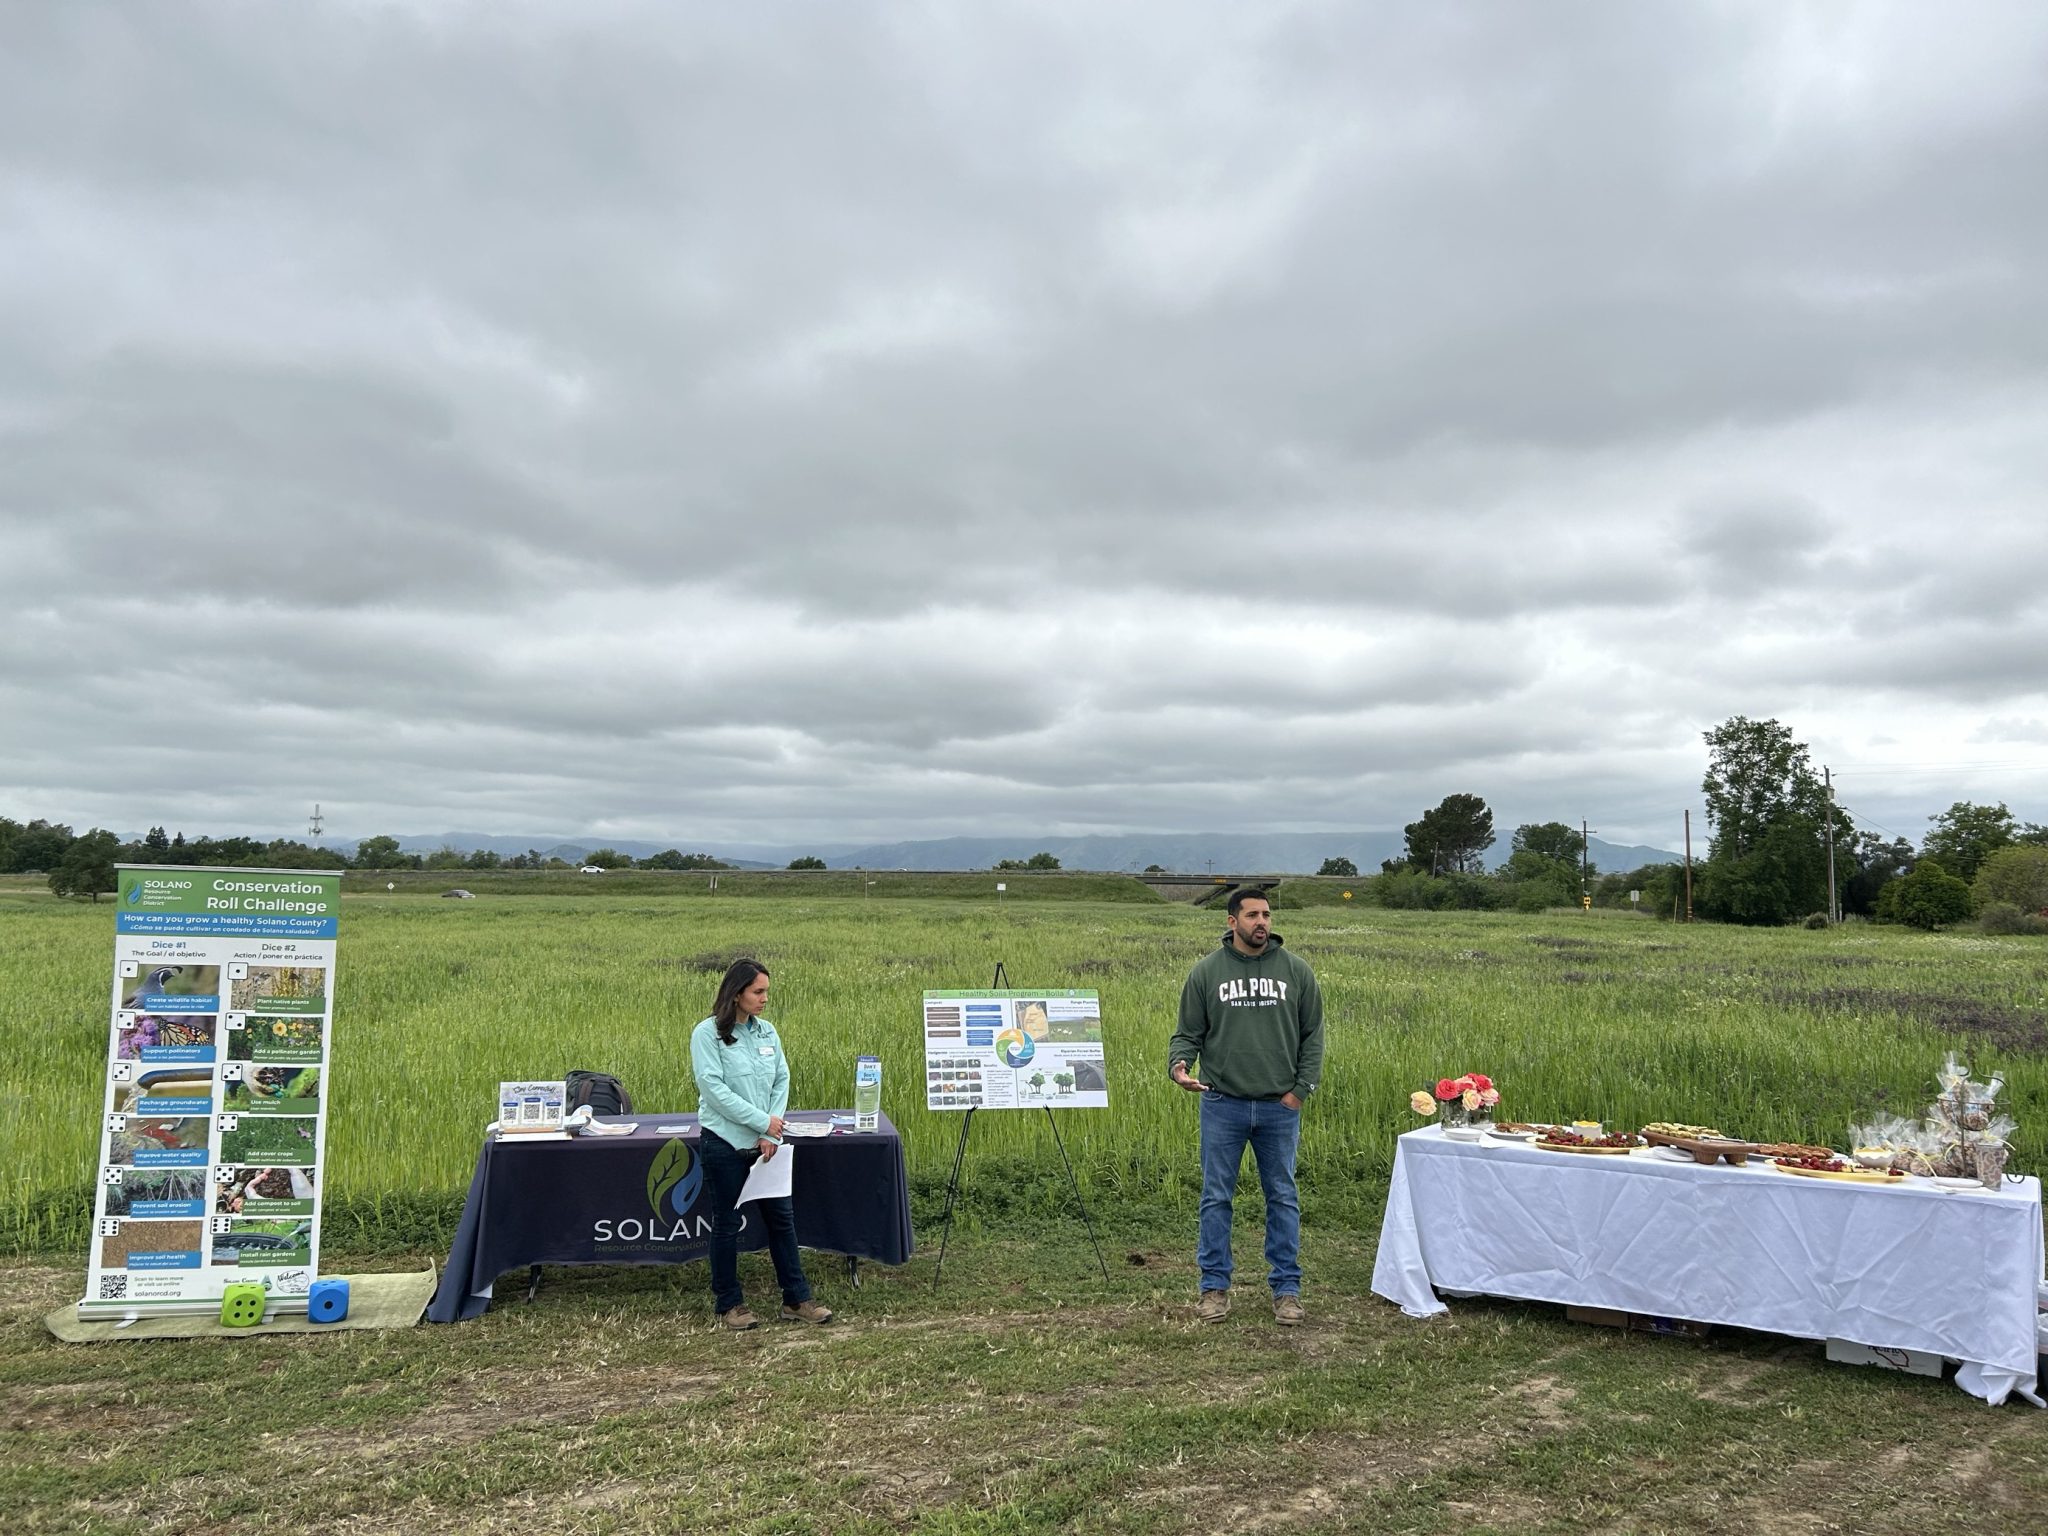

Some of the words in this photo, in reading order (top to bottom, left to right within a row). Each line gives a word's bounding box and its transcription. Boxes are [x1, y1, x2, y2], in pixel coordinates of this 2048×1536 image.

[144, 880, 192, 889] SOLANO
[213, 879, 323, 895] Conservation
[207, 897, 238, 910] Roll
[244, 897, 327, 915] Challenge
[124, 914, 144, 922] How
[186, 917, 210, 925] grow
[220, 916, 254, 926] healthy
[256, 918, 287, 926] Solano
[290, 918, 327, 928] County?
[152, 941, 174, 949] Dice
[176, 941, 187, 949] #1
[262, 944, 283, 952] Dice
[284, 944, 296, 952] #2
[177, 951, 206, 959] objetivo
[960, 990, 988, 998] Healthy
[1219, 979, 1248, 1002] CAL
[1249, 977, 1287, 1001] POLY
[594, 1244, 642, 1252] Resource
[644, 1237, 708, 1252] Conservation
